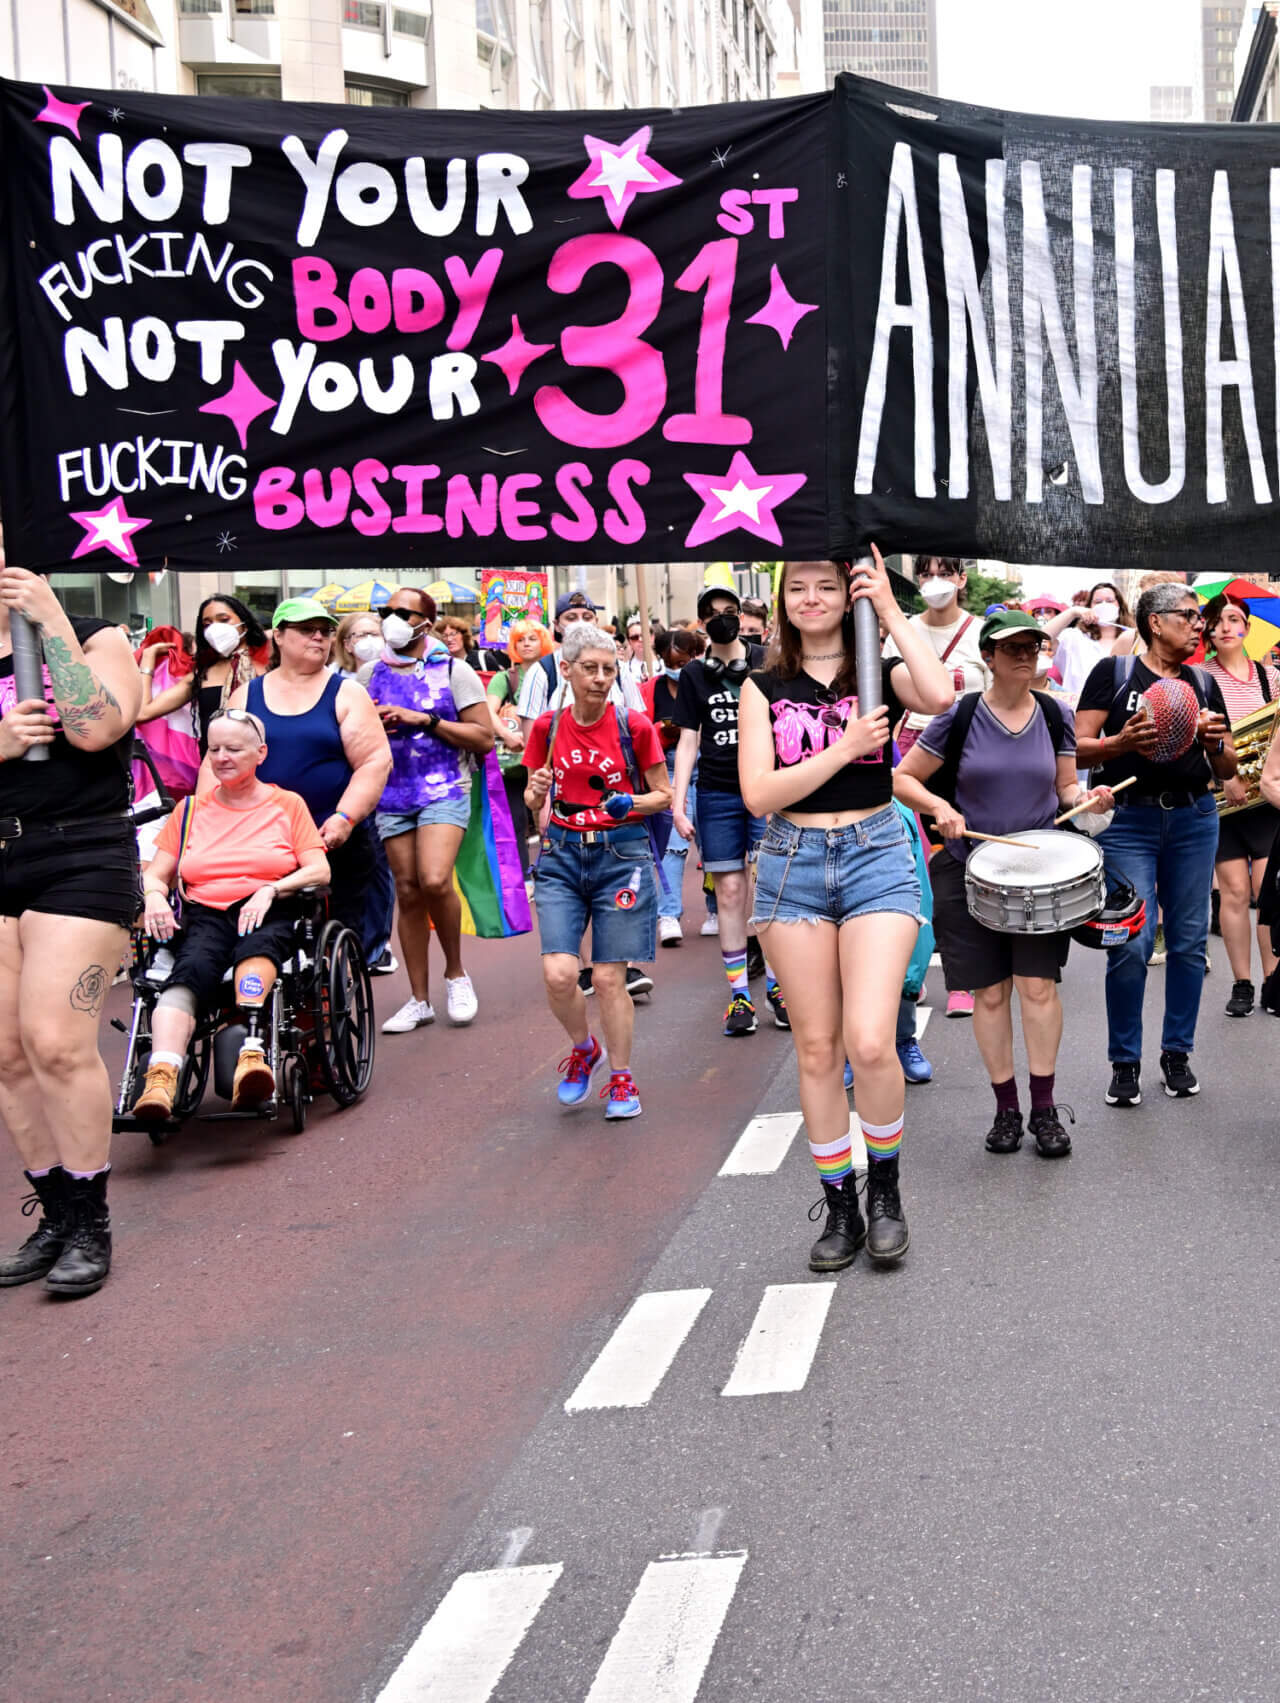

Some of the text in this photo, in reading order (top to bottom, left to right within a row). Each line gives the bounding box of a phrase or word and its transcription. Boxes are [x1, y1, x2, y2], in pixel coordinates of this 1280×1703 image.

[50, 129, 533, 247] NOT YOUR
[40, 232, 503, 351] FUCKING BODY
[65, 317, 480, 434] NOT YOUR
[59, 436, 651, 544] FUCKING BUSINESS
